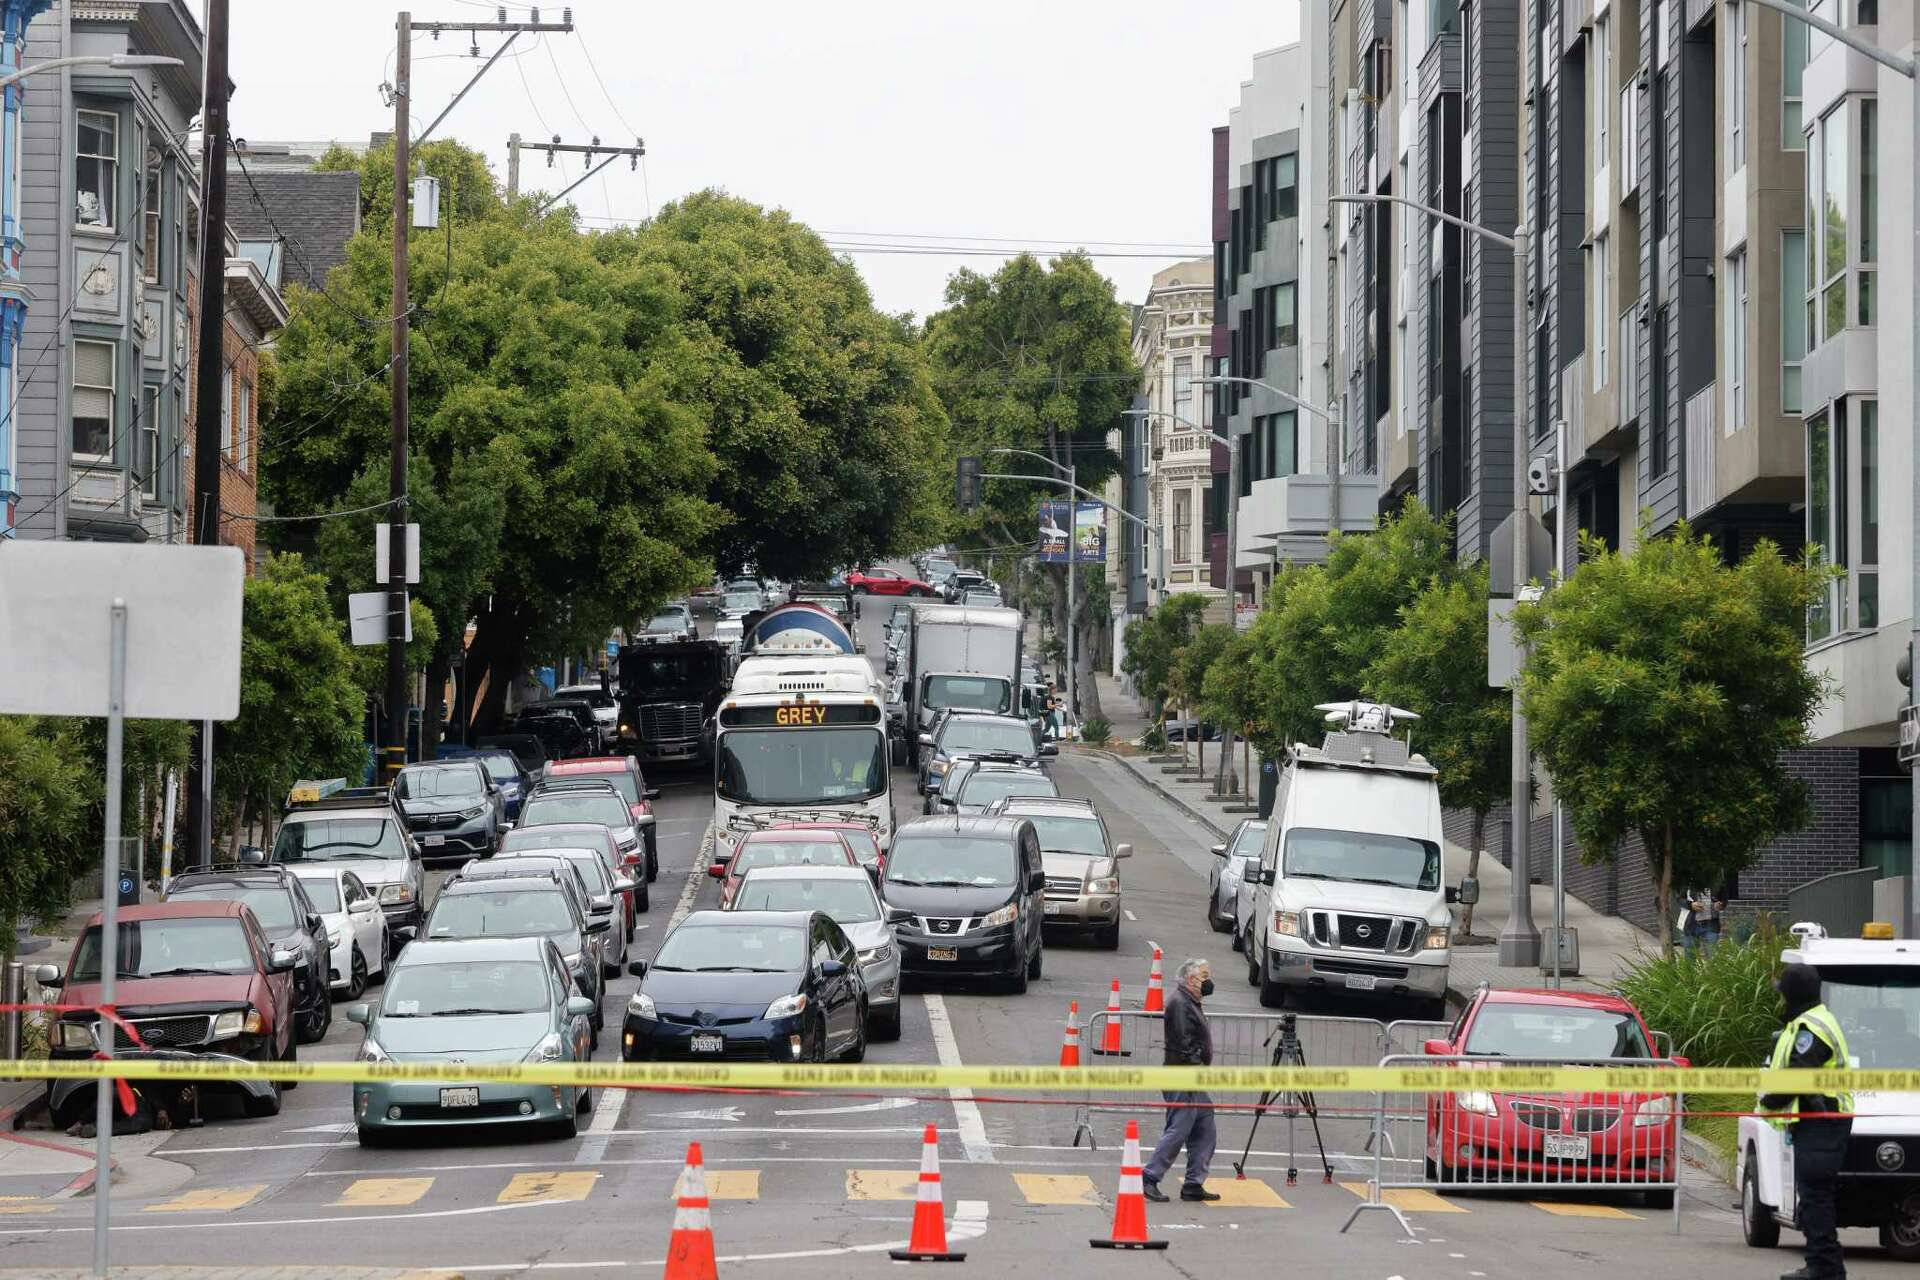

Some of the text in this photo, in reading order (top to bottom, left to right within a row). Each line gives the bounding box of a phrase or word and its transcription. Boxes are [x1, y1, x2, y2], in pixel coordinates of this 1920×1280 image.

[1081, 537, 1100, 546] BIG
[776, 707, 826, 725] GREY
[365, 1065, 523, 1078] CAUTION DO NOT ENTER
[573, 1066, 731, 1080] CAUTION DO NOT ENTER
[781, 1068, 938, 1082] CAUTION DO NOT ENTER
[988, 1069, 1144, 1084] CAUTION DO NOT ENTER
[1194, 1070, 1350, 1085] CAUTION DO NOT ENTER
[1399, 1071, 1556, 1086] CAUTION DO NOT ENTER
[1605, 1071, 1762, 1087] CAUTION DO NOT ENTER
[1812, 1072, 1856, 1087] ENTER
[1859, 1072, 1885, 1087] NOT
[1887, 1072, 1908, 1087] DO
